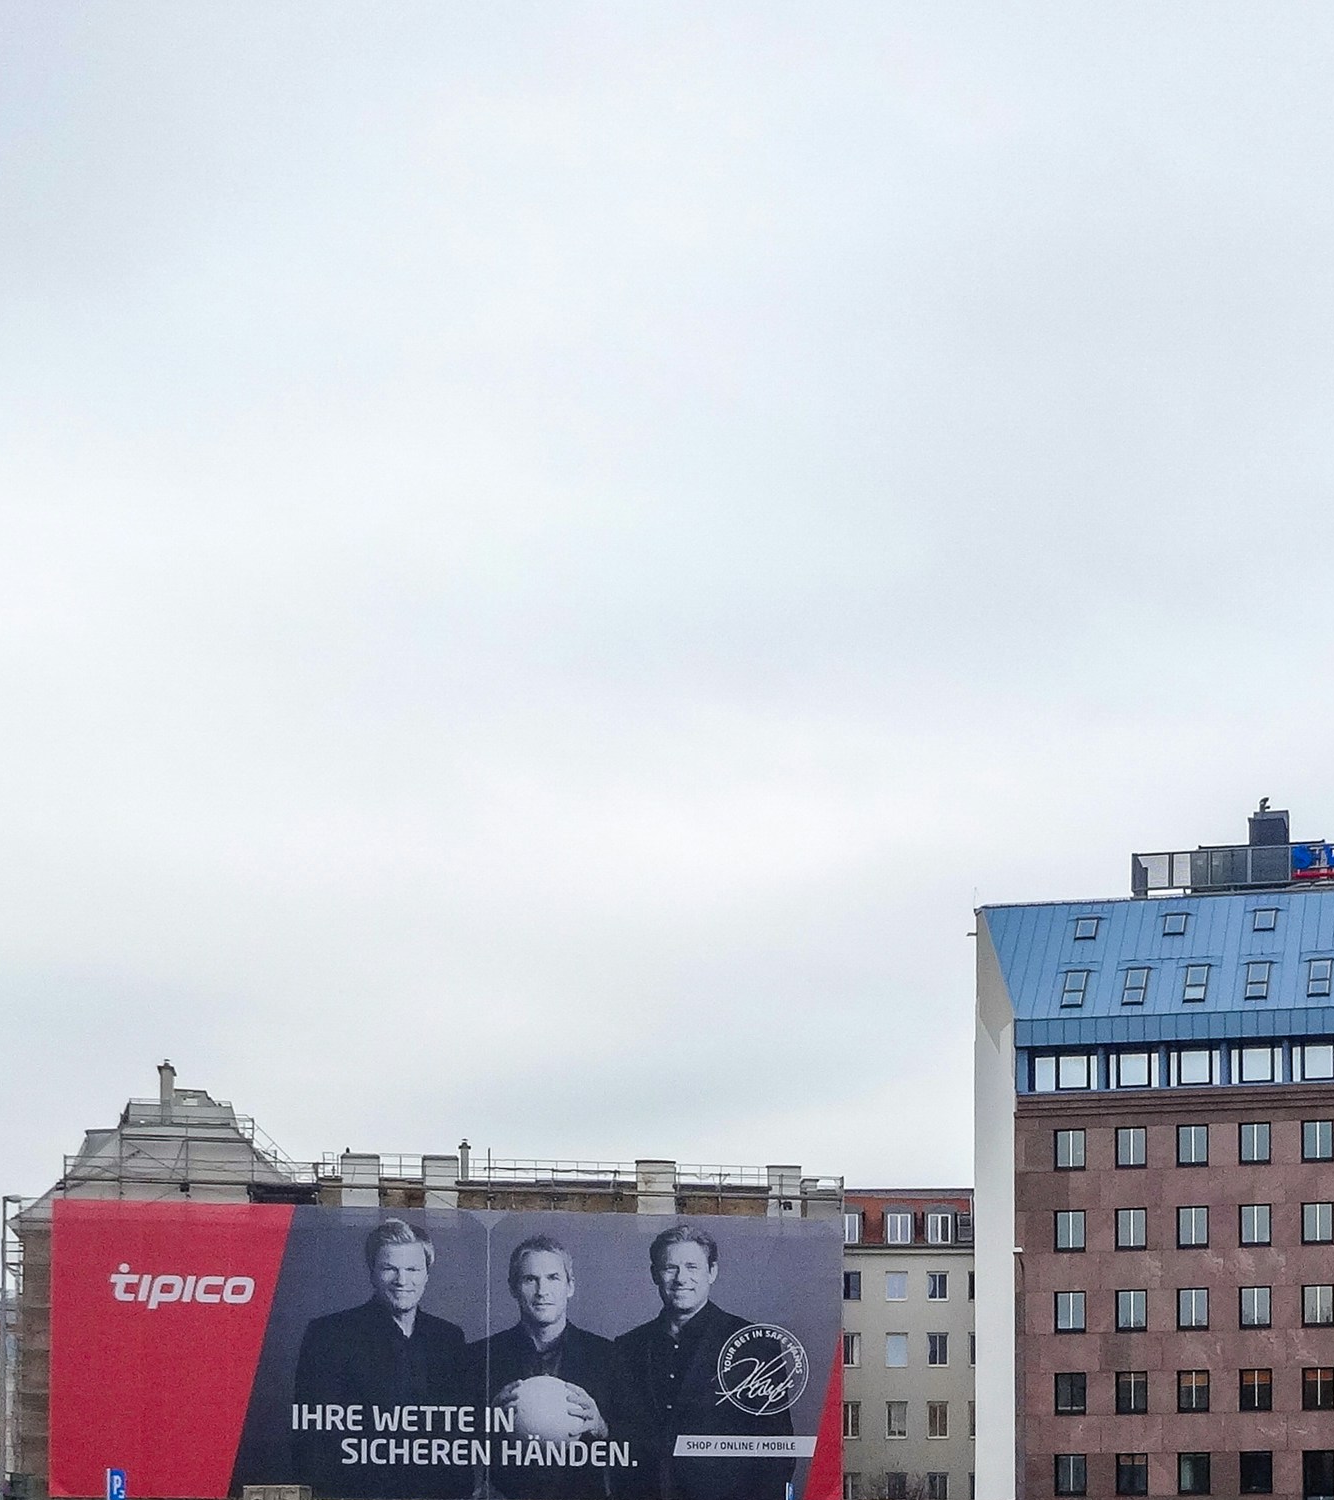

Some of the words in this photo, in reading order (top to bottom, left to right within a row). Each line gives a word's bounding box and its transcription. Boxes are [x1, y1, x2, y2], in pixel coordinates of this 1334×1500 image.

[110, 1263, 255, 1309] tipico
[723, 1347, 736, 1373] YOUR
[734, 1334, 752, 1348] BET
[752, 1330, 763, 1338] IN
[765, 1330, 788, 1344] SAFE
[292, 1404, 363, 1431] IHRE
[372, 1406, 474, 1433] WETTE
[485, 1407, 514, 1433] IN
[341, 1438, 490, 1465] SICHEREN
[501, 1435, 638, 1467] HÄNDEN.
[686, 1442, 712, 1450] SHOP
[720, 1442, 754, 1450] ONLINE
[762, 1442, 796, 1451] MOBILE
